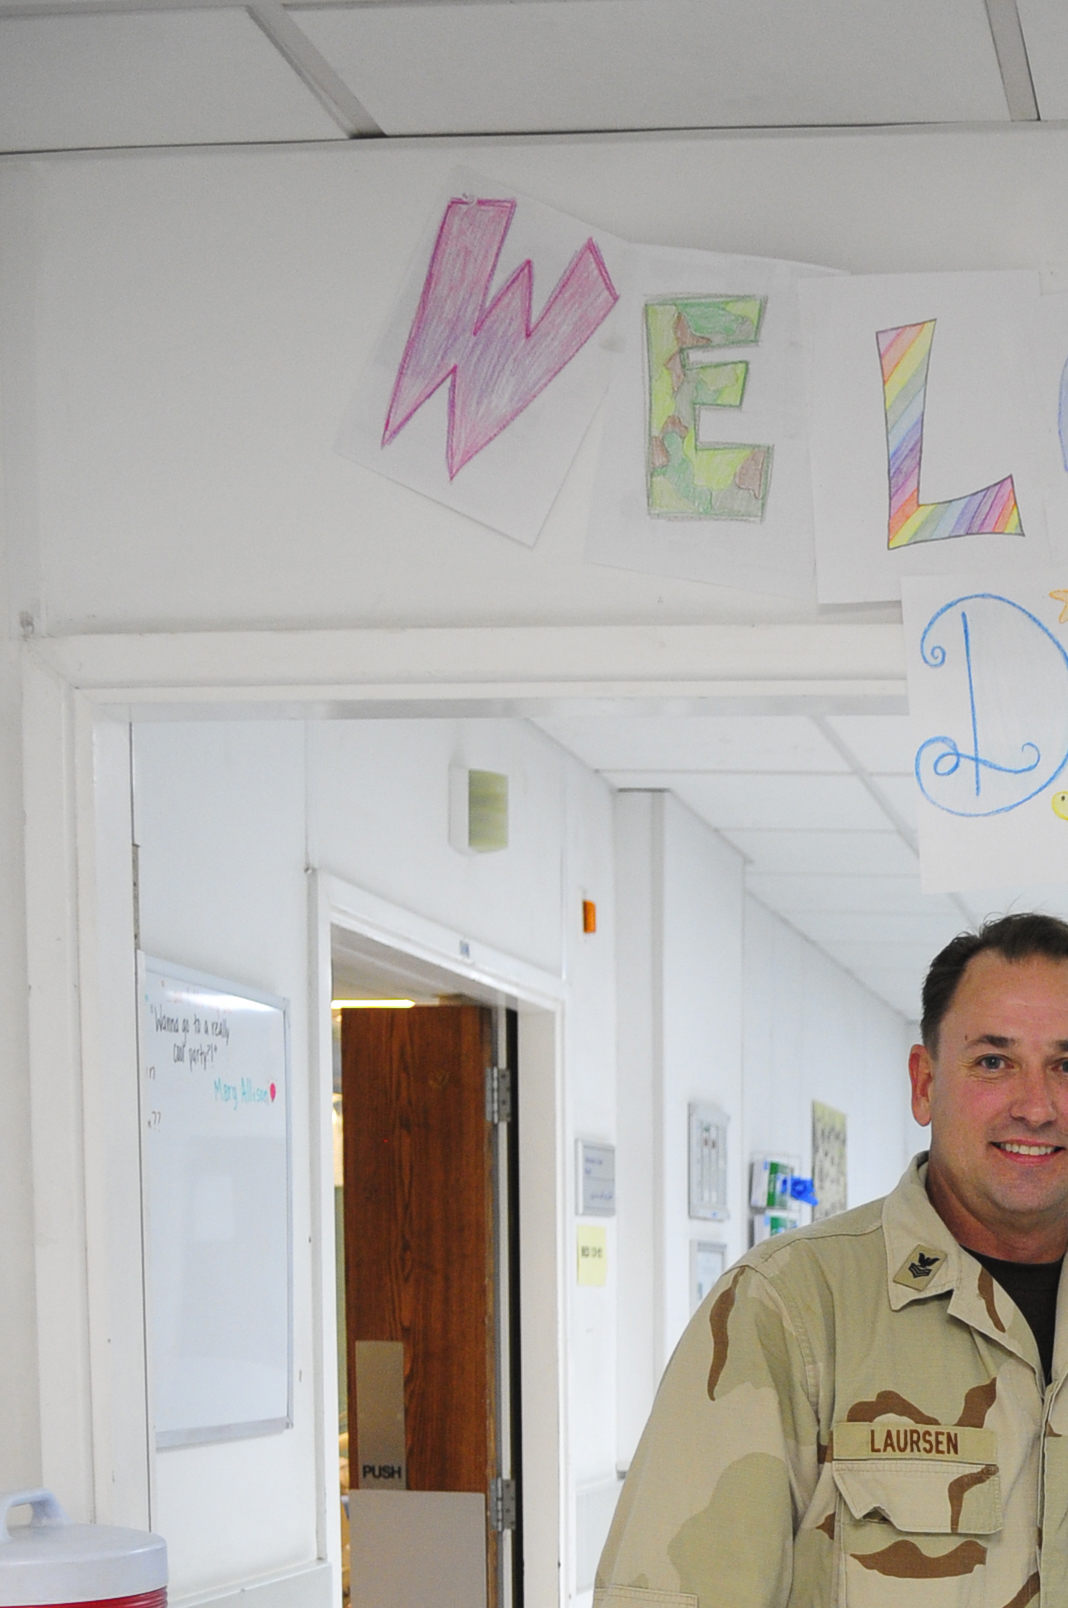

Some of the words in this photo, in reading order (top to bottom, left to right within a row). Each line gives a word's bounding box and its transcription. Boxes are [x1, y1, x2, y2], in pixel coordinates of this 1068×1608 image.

[181, 1018, 190, 1048] go
[193, 1013, 201, 1034] to
[870, 1428, 959, 1456] LAURSEN
[362, 1464, 402, 1479] PUSH
